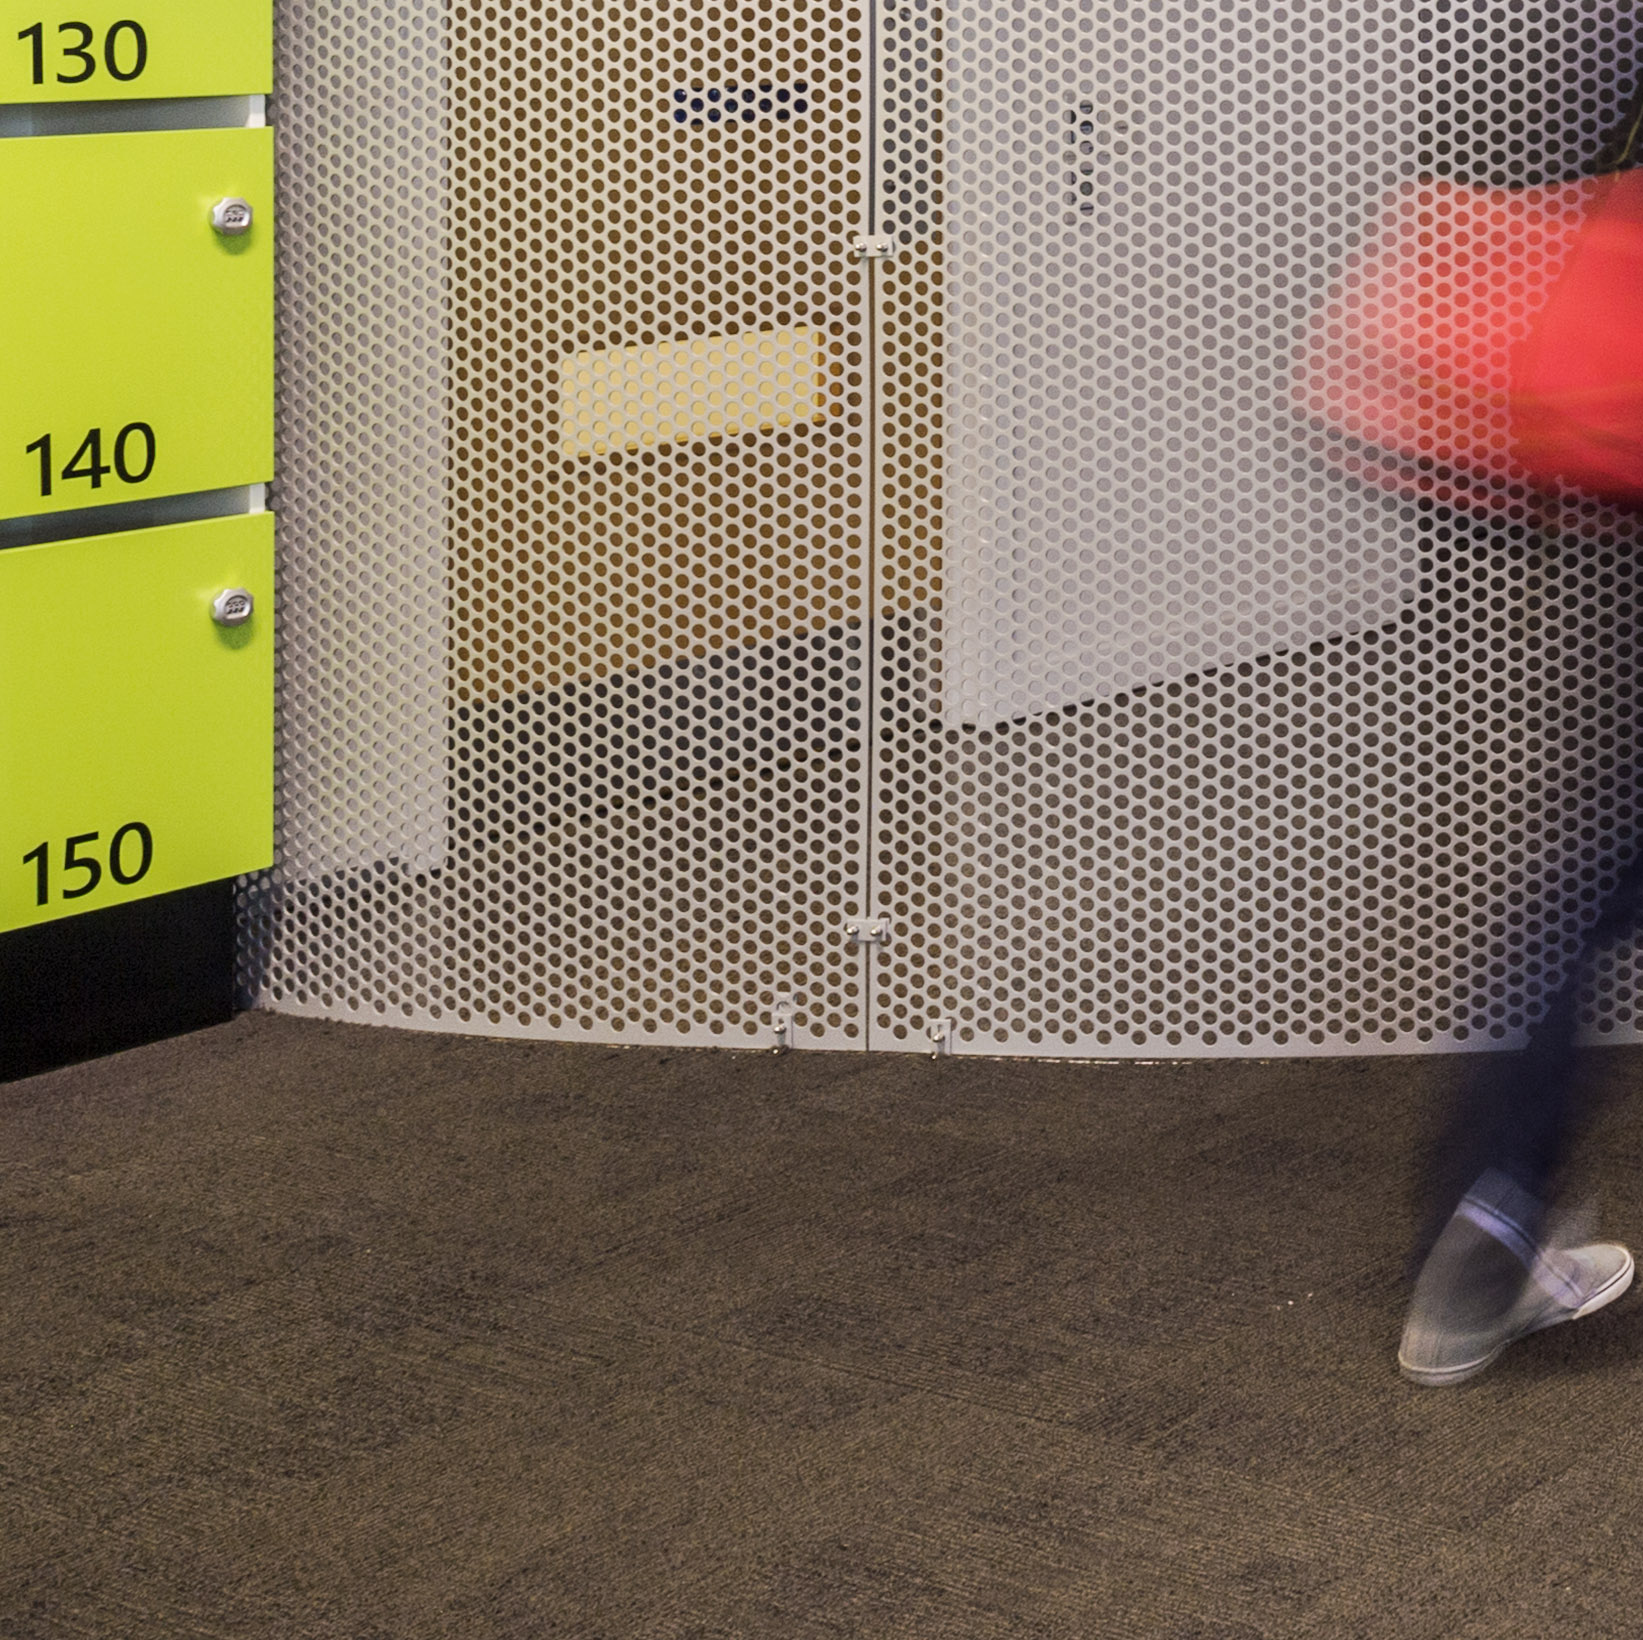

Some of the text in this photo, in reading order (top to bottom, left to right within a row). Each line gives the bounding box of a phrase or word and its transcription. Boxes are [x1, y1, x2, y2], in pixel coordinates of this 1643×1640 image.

[18, 20, 147, 84] 130
[26, 422, 156, 497] 140
[23, 822, 154, 907] 150
